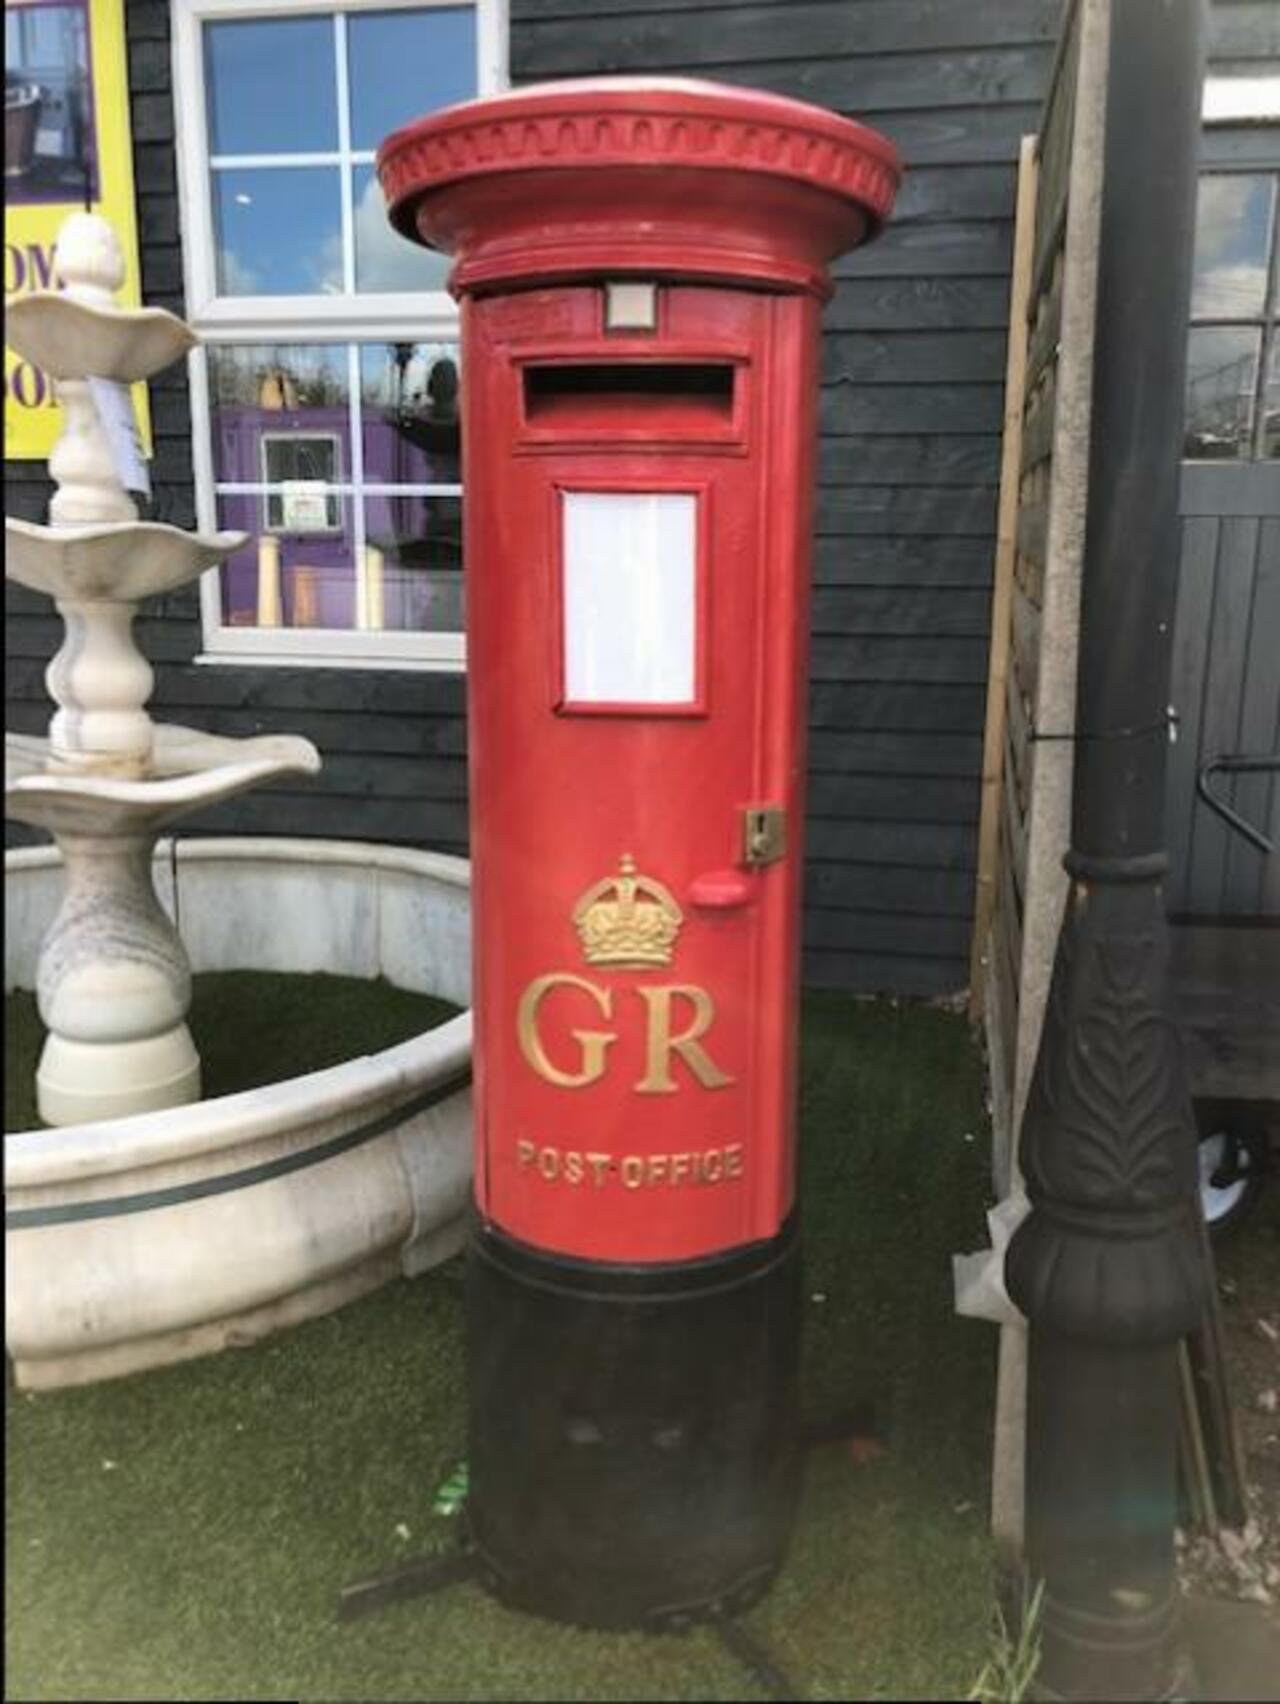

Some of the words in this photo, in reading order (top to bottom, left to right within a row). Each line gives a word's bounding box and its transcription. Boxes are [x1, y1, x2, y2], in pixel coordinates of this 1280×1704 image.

[517, 972, 737, 1094] GR
[517, 1139, 612, 1186] POST
[621, 1143, 743, 1188] OFFICE
